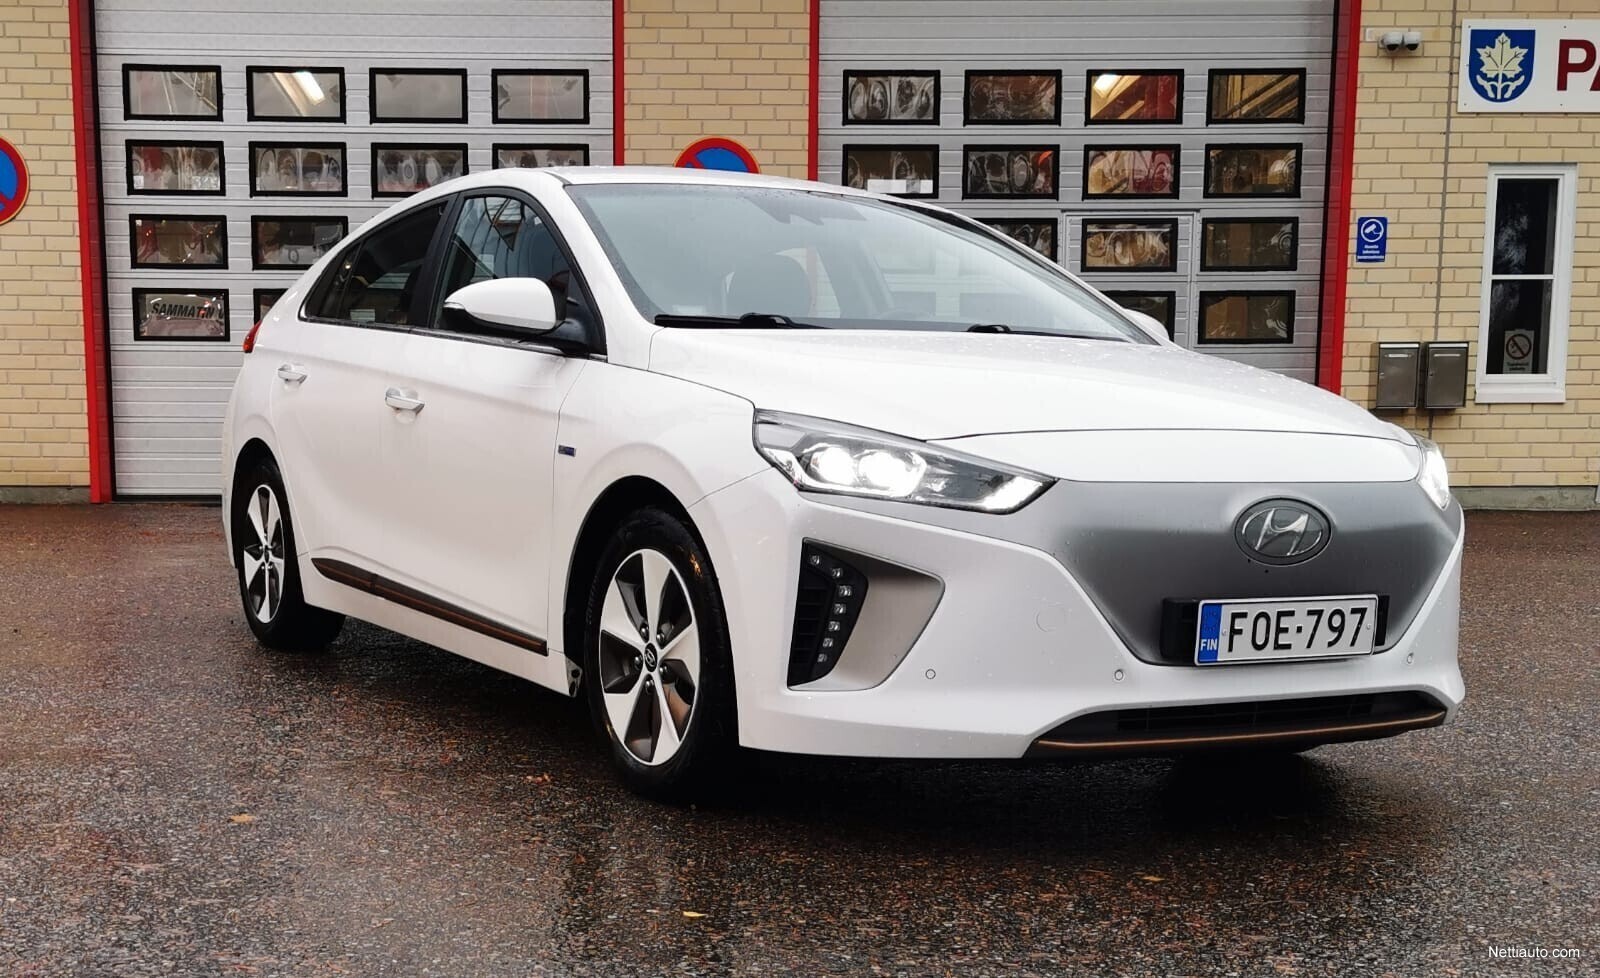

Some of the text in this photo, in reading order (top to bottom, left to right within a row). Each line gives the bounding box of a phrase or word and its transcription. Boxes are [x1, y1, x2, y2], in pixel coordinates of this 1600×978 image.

[1557, 39, 1600, 91] P
[151, 302, 215, 319] SAMMATIN
[1200, 607, 1368, 652] FIN FOE-797
